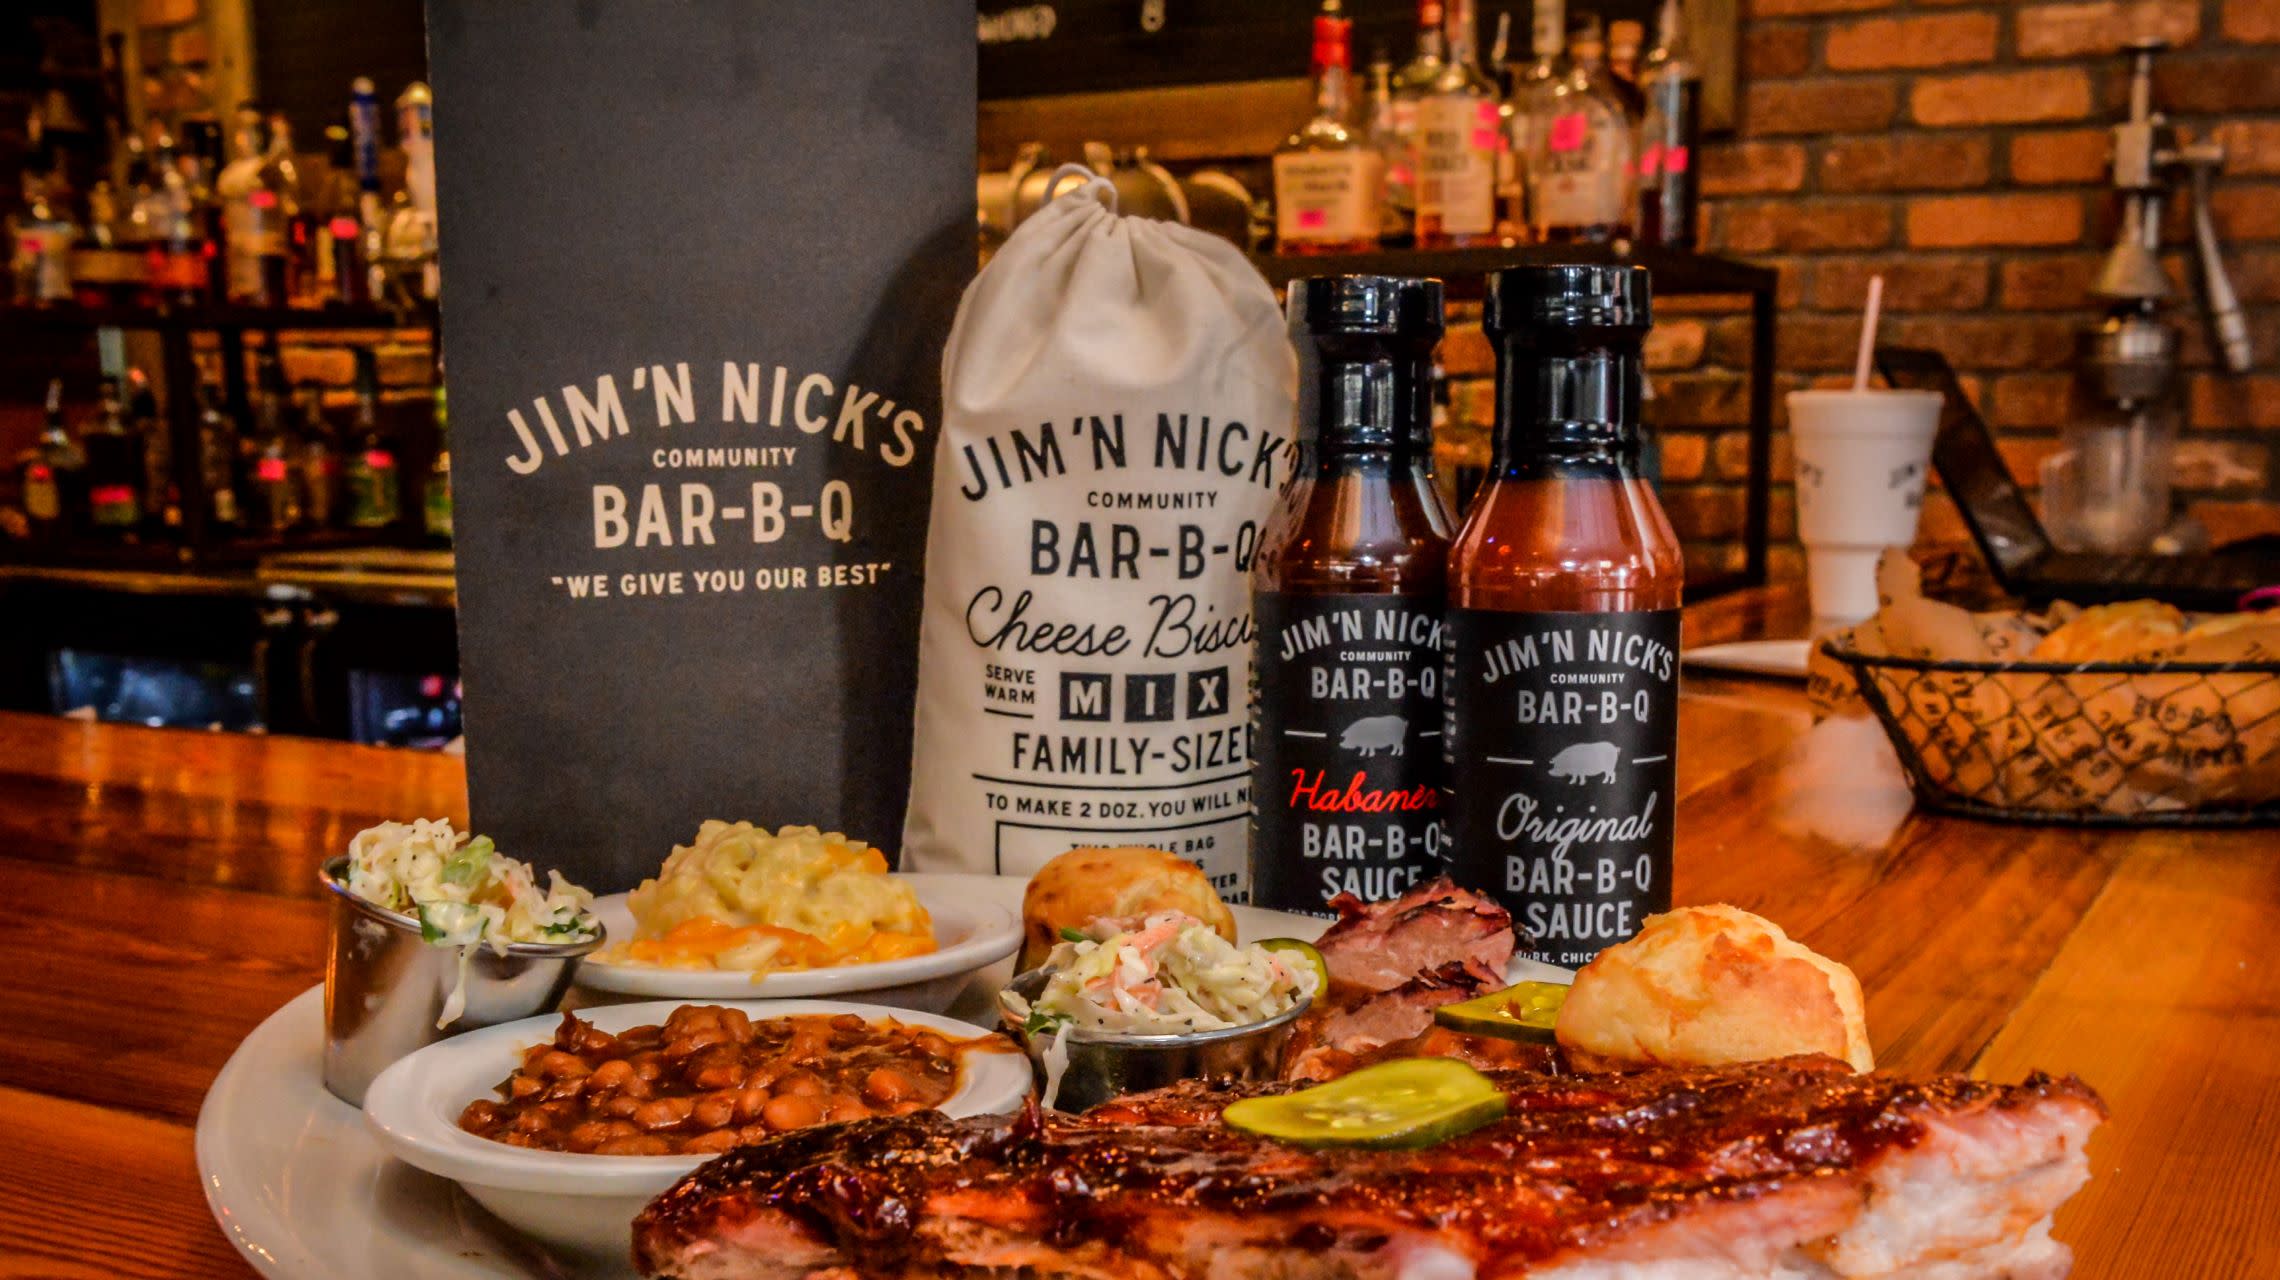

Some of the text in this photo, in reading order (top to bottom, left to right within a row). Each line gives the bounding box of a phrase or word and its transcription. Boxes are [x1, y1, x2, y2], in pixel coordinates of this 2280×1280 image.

[505, 361, 924, 474] JIM'N NICK'S
[652, 447, 797, 468] COMMUNITY
[961, 414, 1127, 502] JIM'N
[593, 480, 852, 548] BAR-B-Q
[1087, 491, 1218, 510] COMMUNITY
[1030, 519, 1256, 580] BAR-B-Q
[620, 572, 684, 596] GIVE
[693, 569, 745, 593] YOU
[755, 567, 807, 590] OUR
[966, 586, 1250, 658] Cheese Biscu
[1281, 610, 1443, 661] JIM'N NICK
[985, 664, 1035, 684] SERVE
[1340, 651, 1412, 661] COMMUNITY
[1482, 629, 1673, 683] JIM'N NICK'S
[985, 683, 1035, 704] WARM
[1311, 667, 1435, 699] BAR-B-Q
[1550, 673, 1625, 684] COMMUNITY
[1518, 689, 1648, 724] BAR-B-Q
[1013, 723, 1251, 775] FAMILY-SIZE
[986, 793, 1008, 810] TO
[1016, 797, 1072, 817] MAKE
[1080, 803, 1091, 817] 2
[1100, 803, 1144, 818] DOZ.
[1149, 800, 1185, 817] YOU
[1192, 792, 1231, 813] WILL
[1185, 836, 1216, 852] BAG
[1303, 822, 1440, 860] BAR-B-Q
[1497, 791, 1657, 862] Original
[1506, 853, 1651, 895] BAR-B-Q
[1527, 900, 1632, 939] SAUCE
